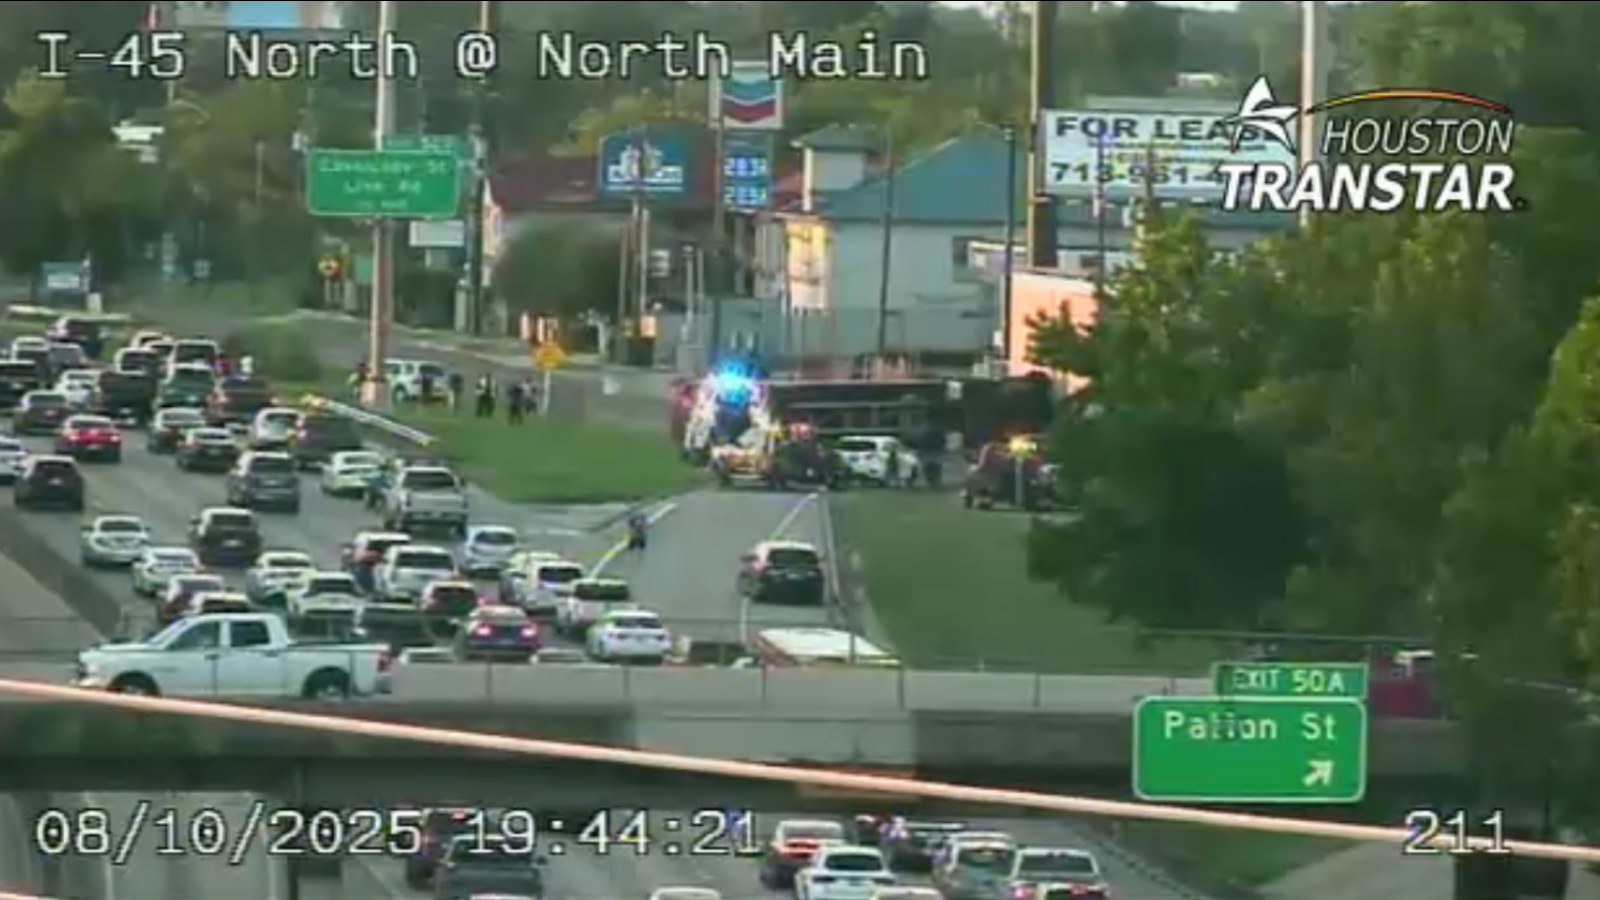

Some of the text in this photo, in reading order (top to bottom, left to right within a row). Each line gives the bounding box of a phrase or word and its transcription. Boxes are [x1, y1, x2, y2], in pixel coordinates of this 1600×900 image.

[1056, 116, 1284, 142] FOR LEAS
[1232, 668, 1346, 693] EXIT 50A
[1301, 712, 1336, 740] St
